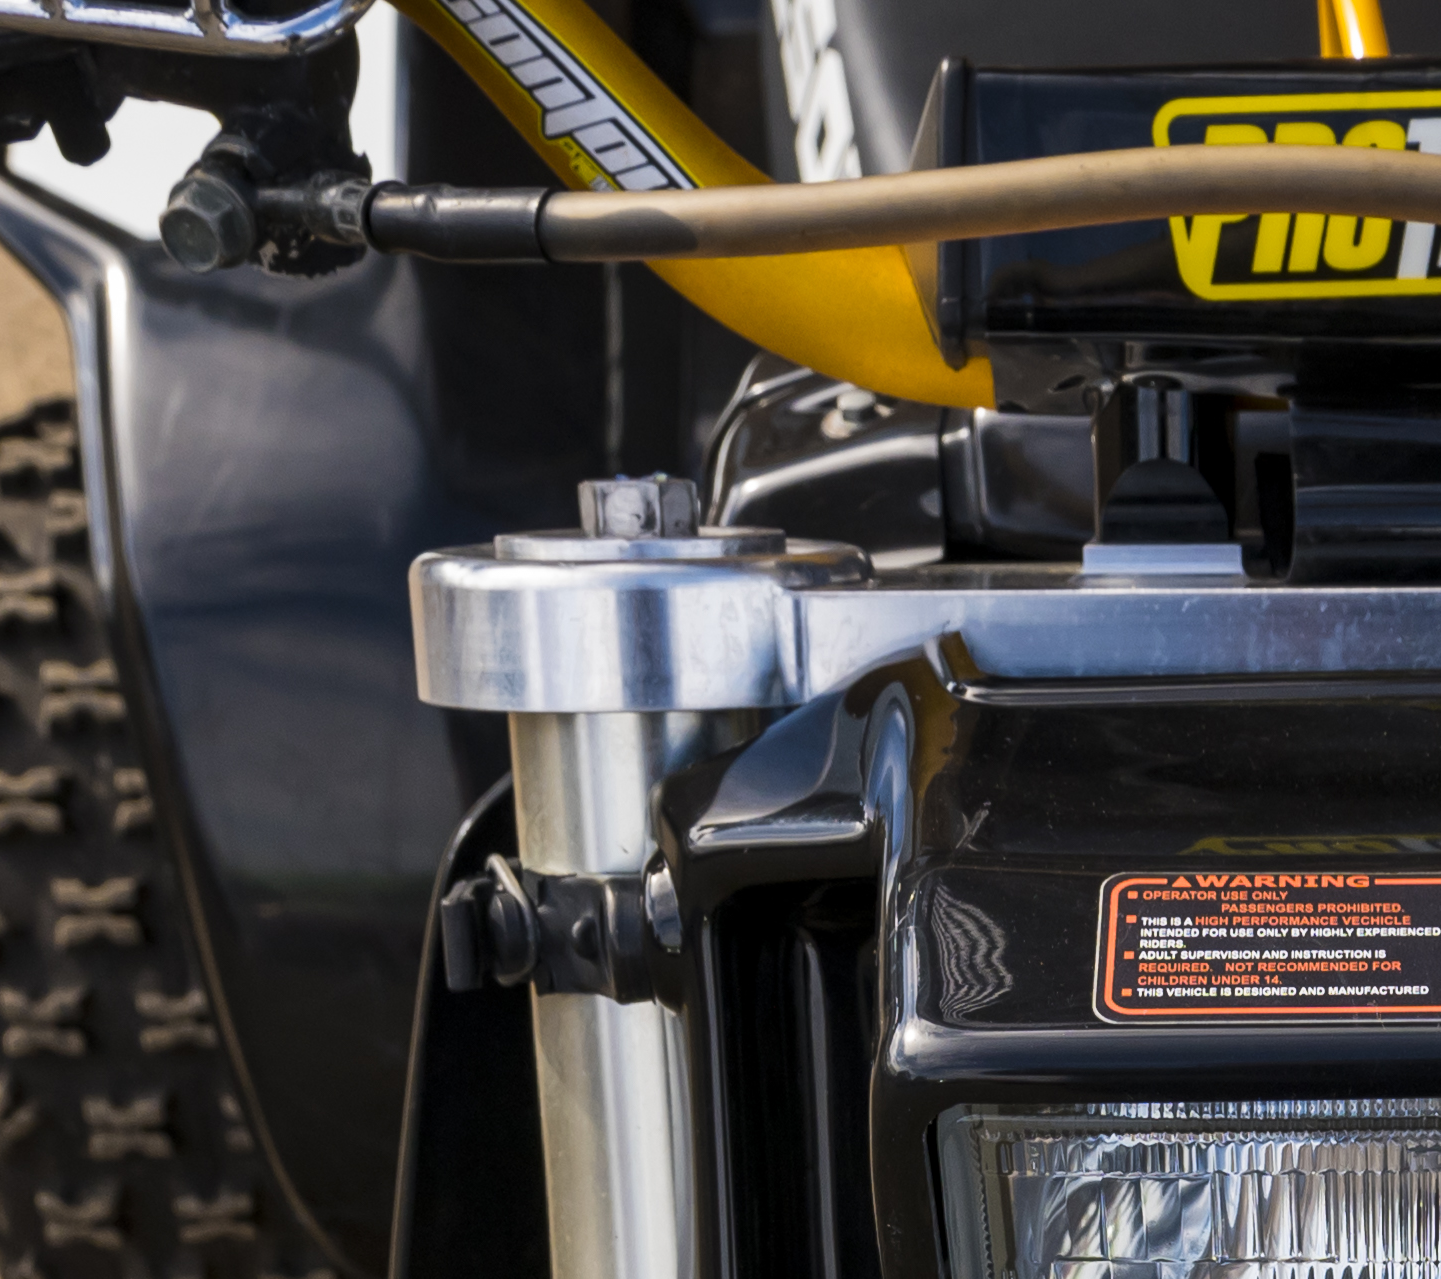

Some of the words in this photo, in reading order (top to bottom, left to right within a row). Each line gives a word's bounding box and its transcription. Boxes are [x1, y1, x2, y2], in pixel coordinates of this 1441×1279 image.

[1196, 875, 1369, 887] WARNING
[1143, 891, 1216, 900] OPERATOR
[1221, 891, 1247, 900] USE
[1252, 891, 1288, 900] ONLY
[1222, 903, 1313, 913] PASSENGERS
[1318, 903, 1404, 913] PROHIBITED.
[1141, 917, 1167, 926] THIS
[1171, 917, 1181, 926] IS
[1184, 917, 1192, 926] A
[1196, 917, 1228, 925] HIGH
[1233, 916, 1338, 925] PERFORMANCE
[1342, 916, 1411, 925] VECHICLE
[1141, 928, 1199, 937] INTENDED
[1202, 928, 1227, 937] FOR
[1230, 928, 1253, 937] USE
[1257, 928, 1288, 937] ONLY
[1291, 928, 1307, 937] BY
[1310, 928, 1354, 937] HIGHLY
[1357, 927, 1441, 936] EXPERIENCED
[1140, 940, 1186, 948] RIDERS.
[1139, 951, 1177, 960] ADULT
[1180, 951, 1259, 959] SUPERVISION
[1262, 951, 1288, 959] AND
[1291, 950, 1371, 959] INSTRUCTION
[1375, 950, 1386, 958] IS
[1139, 963, 1213, 972] REQUIRED.
[1225, 963, 1254, 972] NOT
[1258, 962, 1368, 972] RECOMMENDED
[1373, 961, 1401, 971] FOR
[1138, 976, 1207, 985] CHILDREN
[1212, 975, 1260, 985] UNDER
[1265, 975, 1282, 984] 14.
[1137, 988, 1163, 997] THIS
[1166, 988, 1217, 997] VEHICLE
[1220, 988, 1231, 996] IS
[1235, 987, 1296, 996] DESIGNED
[1299, 987, 1325, 995] AND
[1328, 986, 1429, 995] MANUFACTURED
